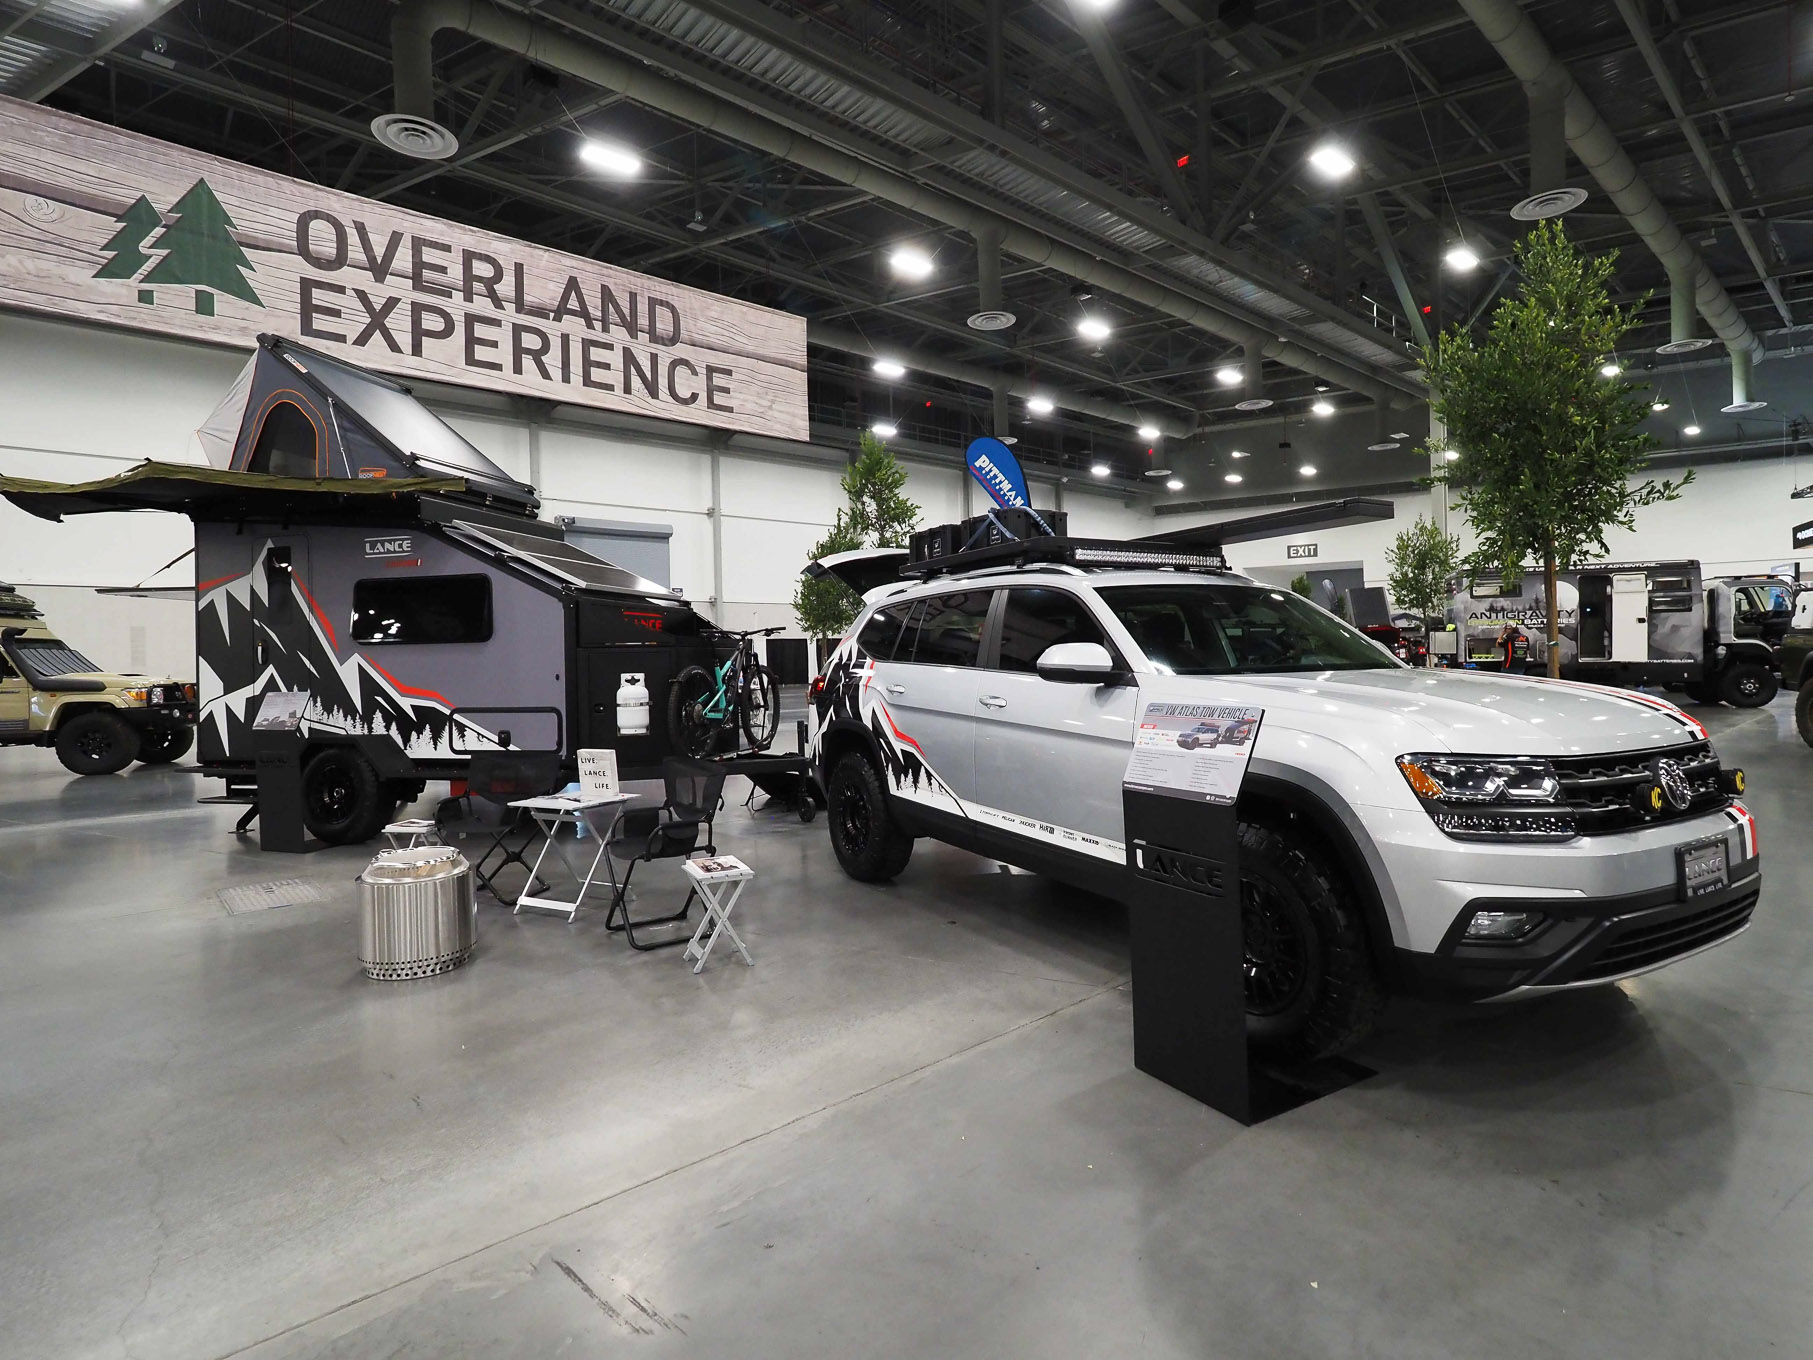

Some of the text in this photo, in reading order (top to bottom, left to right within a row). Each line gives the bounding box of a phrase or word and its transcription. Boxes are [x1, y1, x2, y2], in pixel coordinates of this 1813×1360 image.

[296, 209, 682, 348] OVERLAND
[299, 276, 735, 413] EXPERIENCE
[974, 454, 1025, 507] PITTMAN
[365, 540, 412, 553] LANCE
[1290, 545, 1316, 557] EXIT
[1468, 609, 1576, 620] ANTIGRAVTY
[1164, 705, 1179, 716] VW
[1177, 705, 1200, 717] ATLAS
[1199, 706, 1217, 718] TOW
[1217, 706, 1249, 720] VEHICLE
[594, 782, 612, 790] LIFE.
[1651, 786, 1662, 809] KC
[1135, 848, 1223, 891] LANCE
[1685, 857, 1723, 880] LANCE
